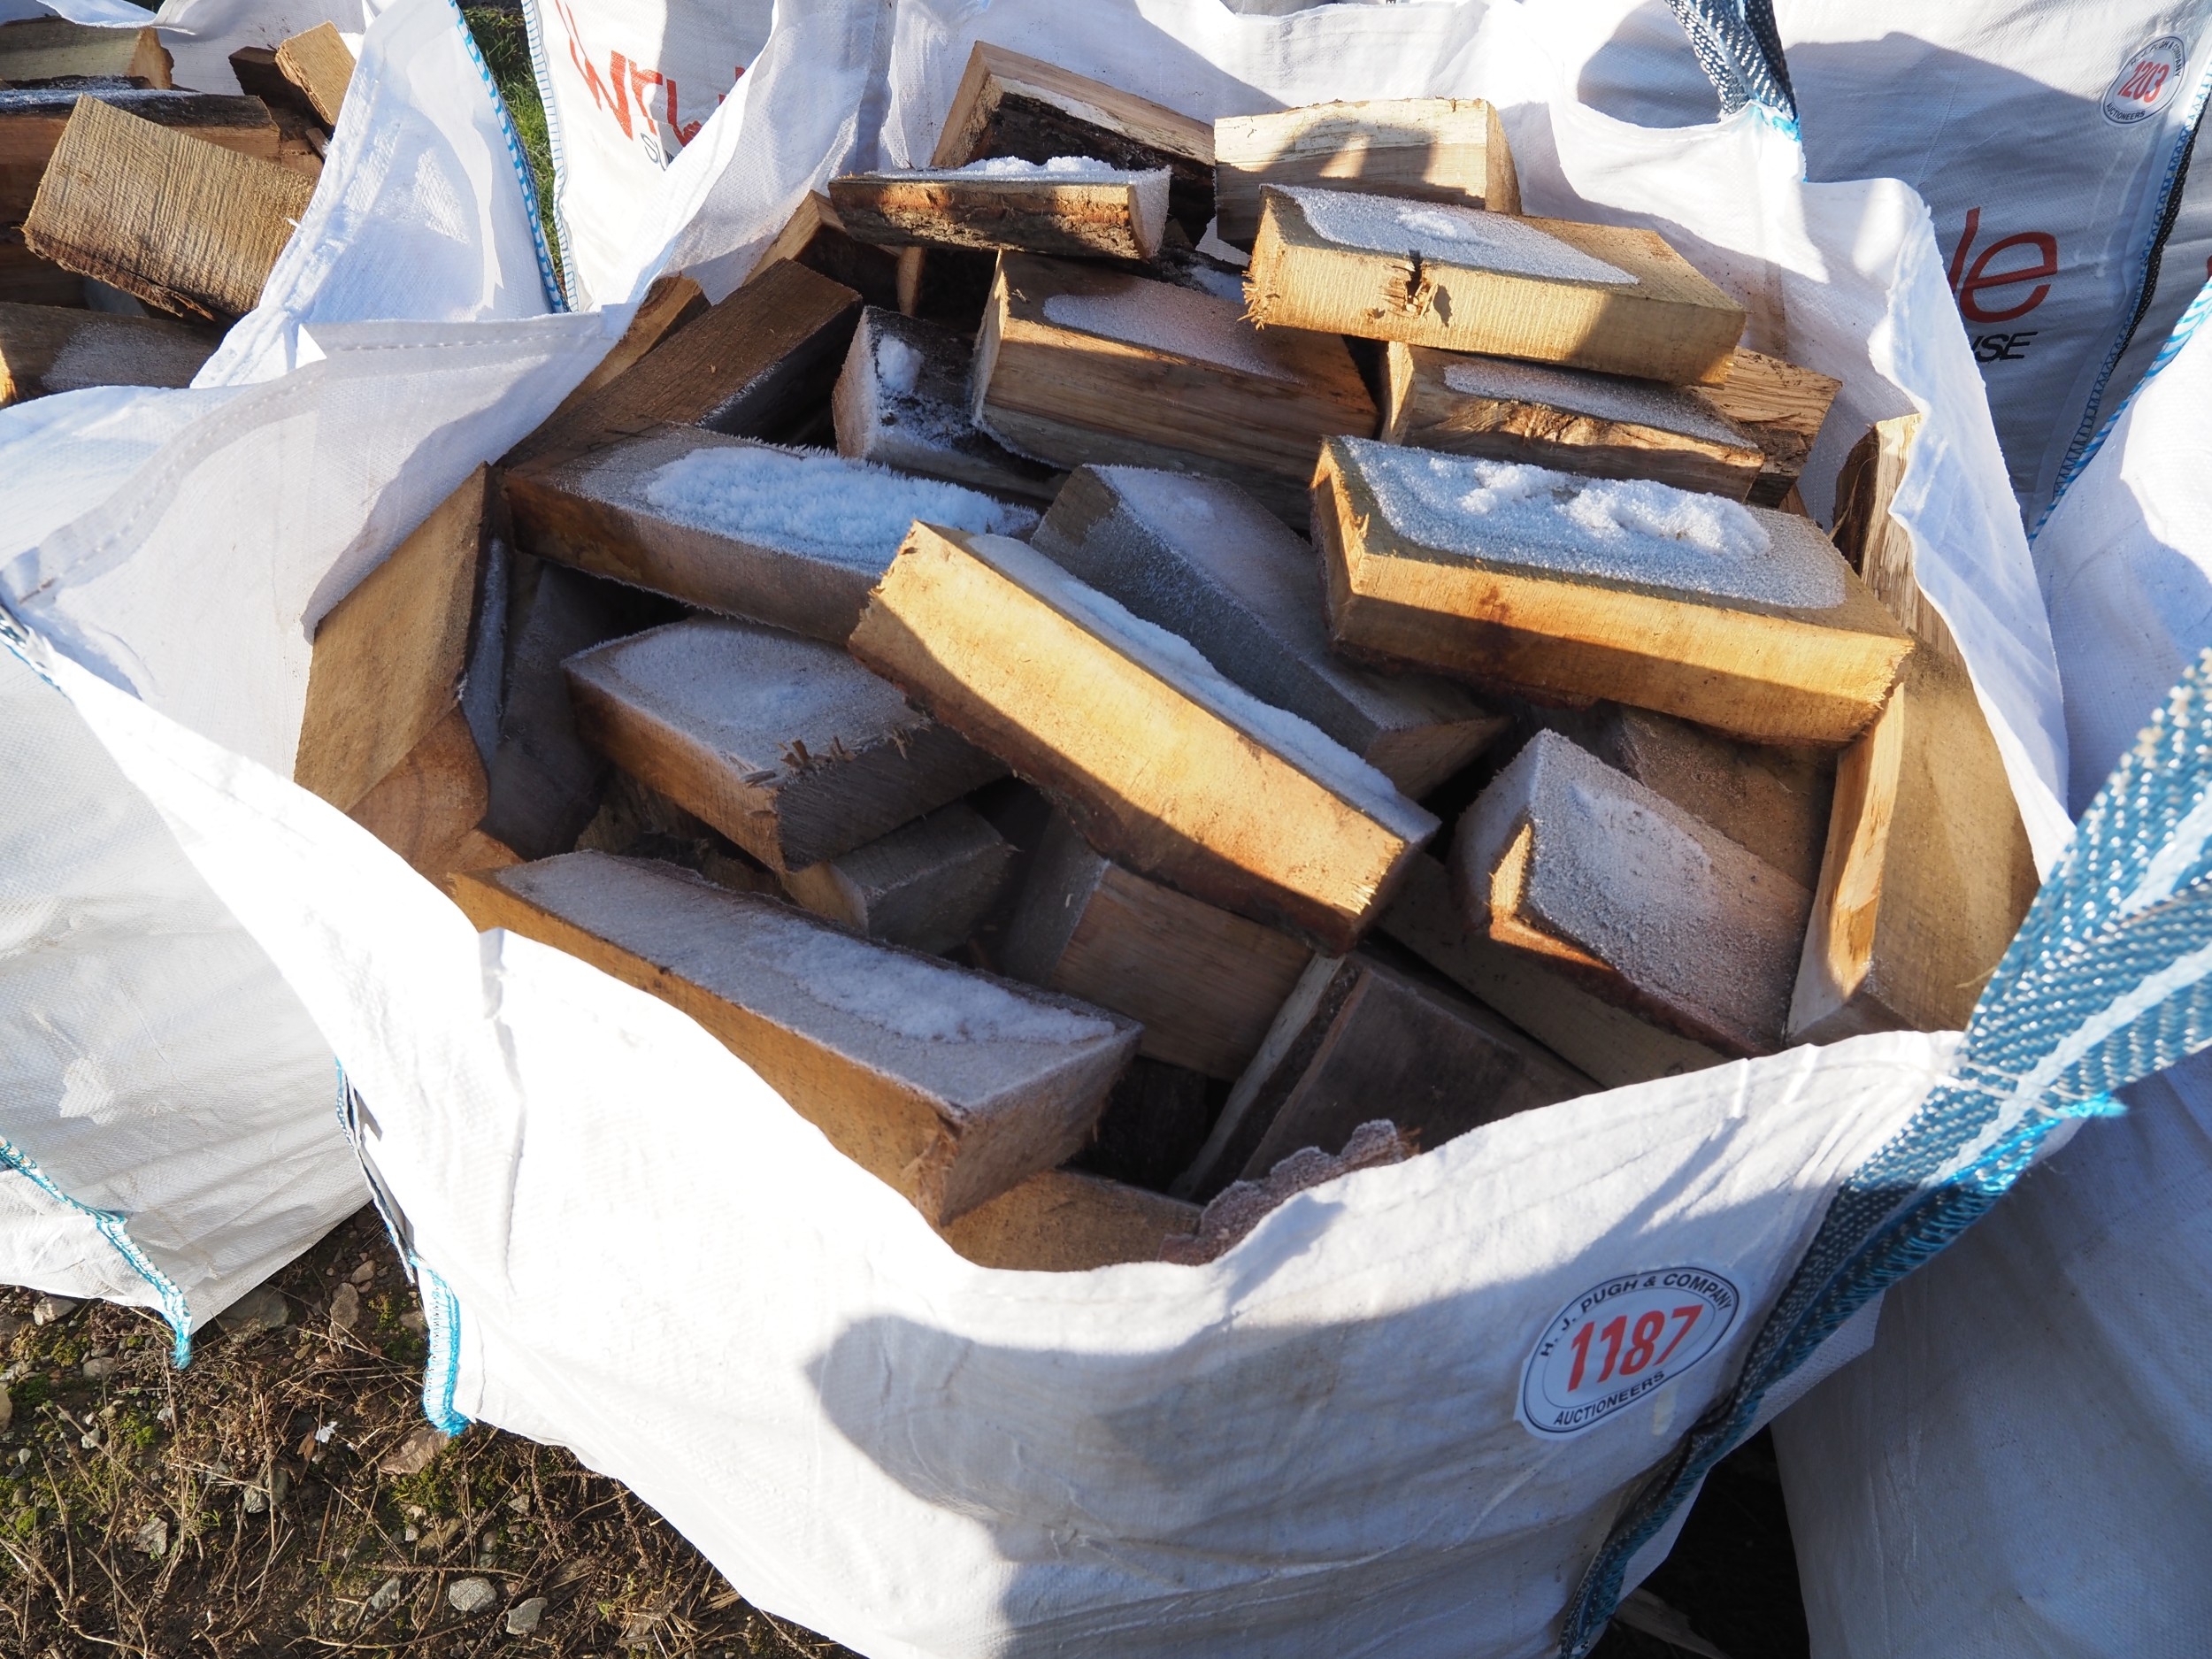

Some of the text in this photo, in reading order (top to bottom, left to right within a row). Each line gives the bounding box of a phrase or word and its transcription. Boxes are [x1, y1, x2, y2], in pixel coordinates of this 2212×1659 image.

[2117, 60, 2170, 103] 1203
[2107, 101, 2146, 120] AUCTIONEERS
[1562, 1317, 1577, 1332] J.
[1580, 1279, 1639, 1314] PUGH
[1643, 1275, 1656, 1287] &
[1663, 1272, 1732, 1311] COMPANY
[1567, 1303, 1704, 1393] 1187
[1553, 1371, 1666, 1426] AUCTIONEERS
